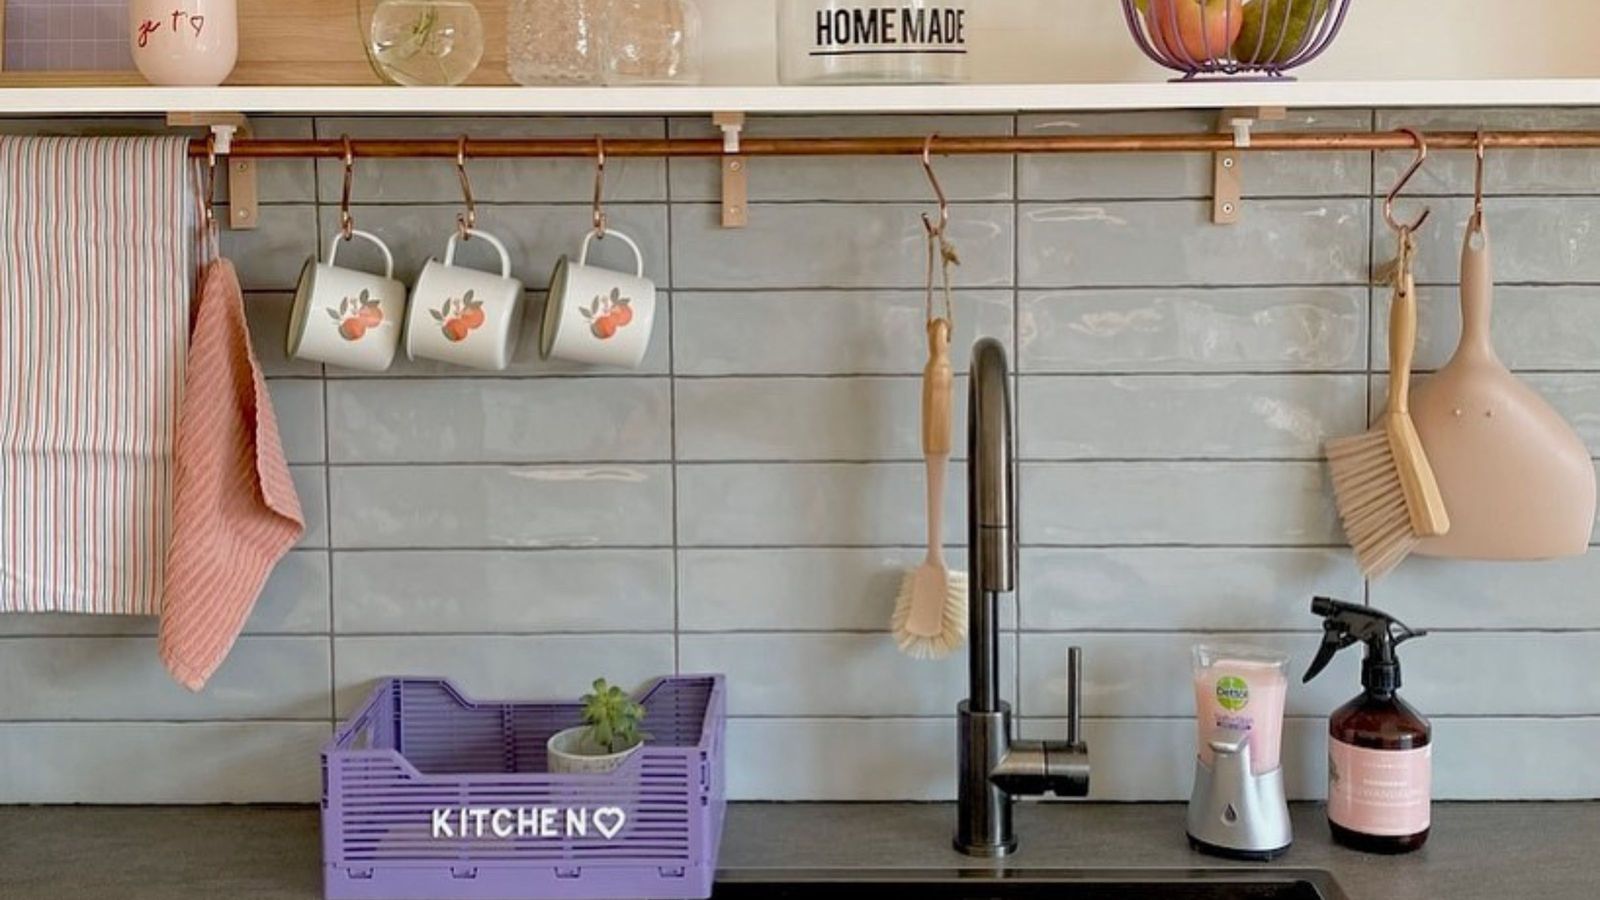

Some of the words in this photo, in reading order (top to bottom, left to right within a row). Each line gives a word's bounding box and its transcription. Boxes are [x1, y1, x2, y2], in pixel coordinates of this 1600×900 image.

[816, 8, 897, 46] HOME
[901, 8, 965, 44] MADE
[432, 806, 587, 838] KITCHEN
